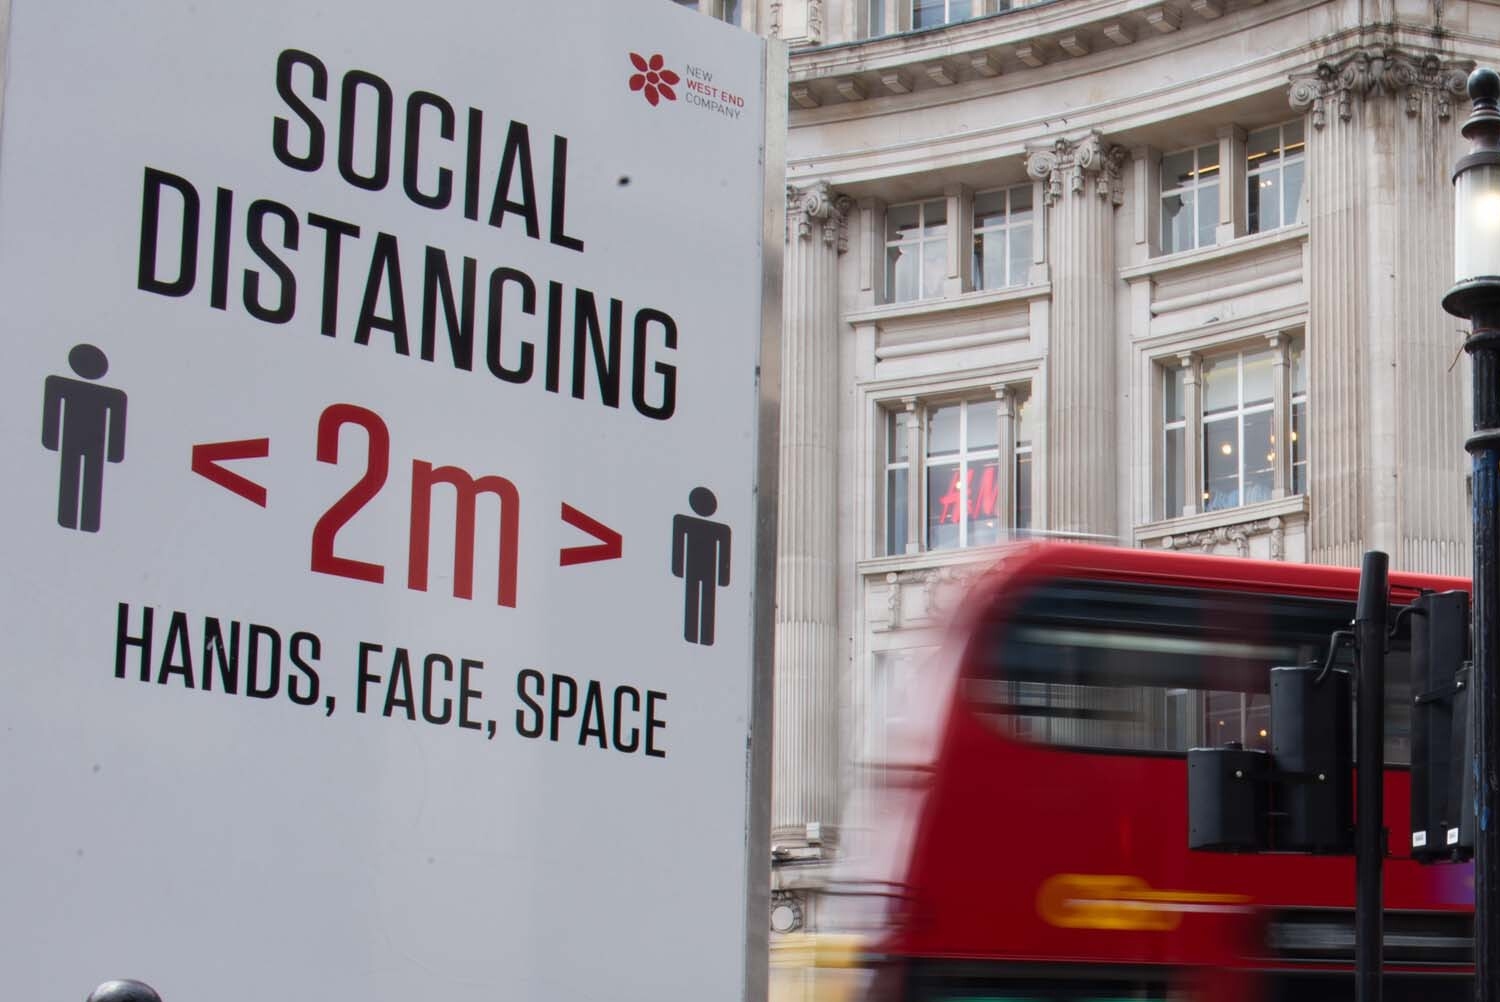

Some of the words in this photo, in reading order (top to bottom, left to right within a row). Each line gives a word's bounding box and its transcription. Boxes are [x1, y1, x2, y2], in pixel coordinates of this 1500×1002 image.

[272, 48, 585, 253] SOCIAL
[685, 91, 741, 120] COMPANY
[686, 63, 713, 82] NEW
[686, 77, 718, 98] WEST
[721, 90, 745, 108] END
[137, 166, 678, 421] DISTANCING
[310, 403, 520, 609] 2m
[114, 601, 336, 718] HANDS,
[356, 641, 497, 740] FACE,
[515, 668, 668, 759] SPACE
